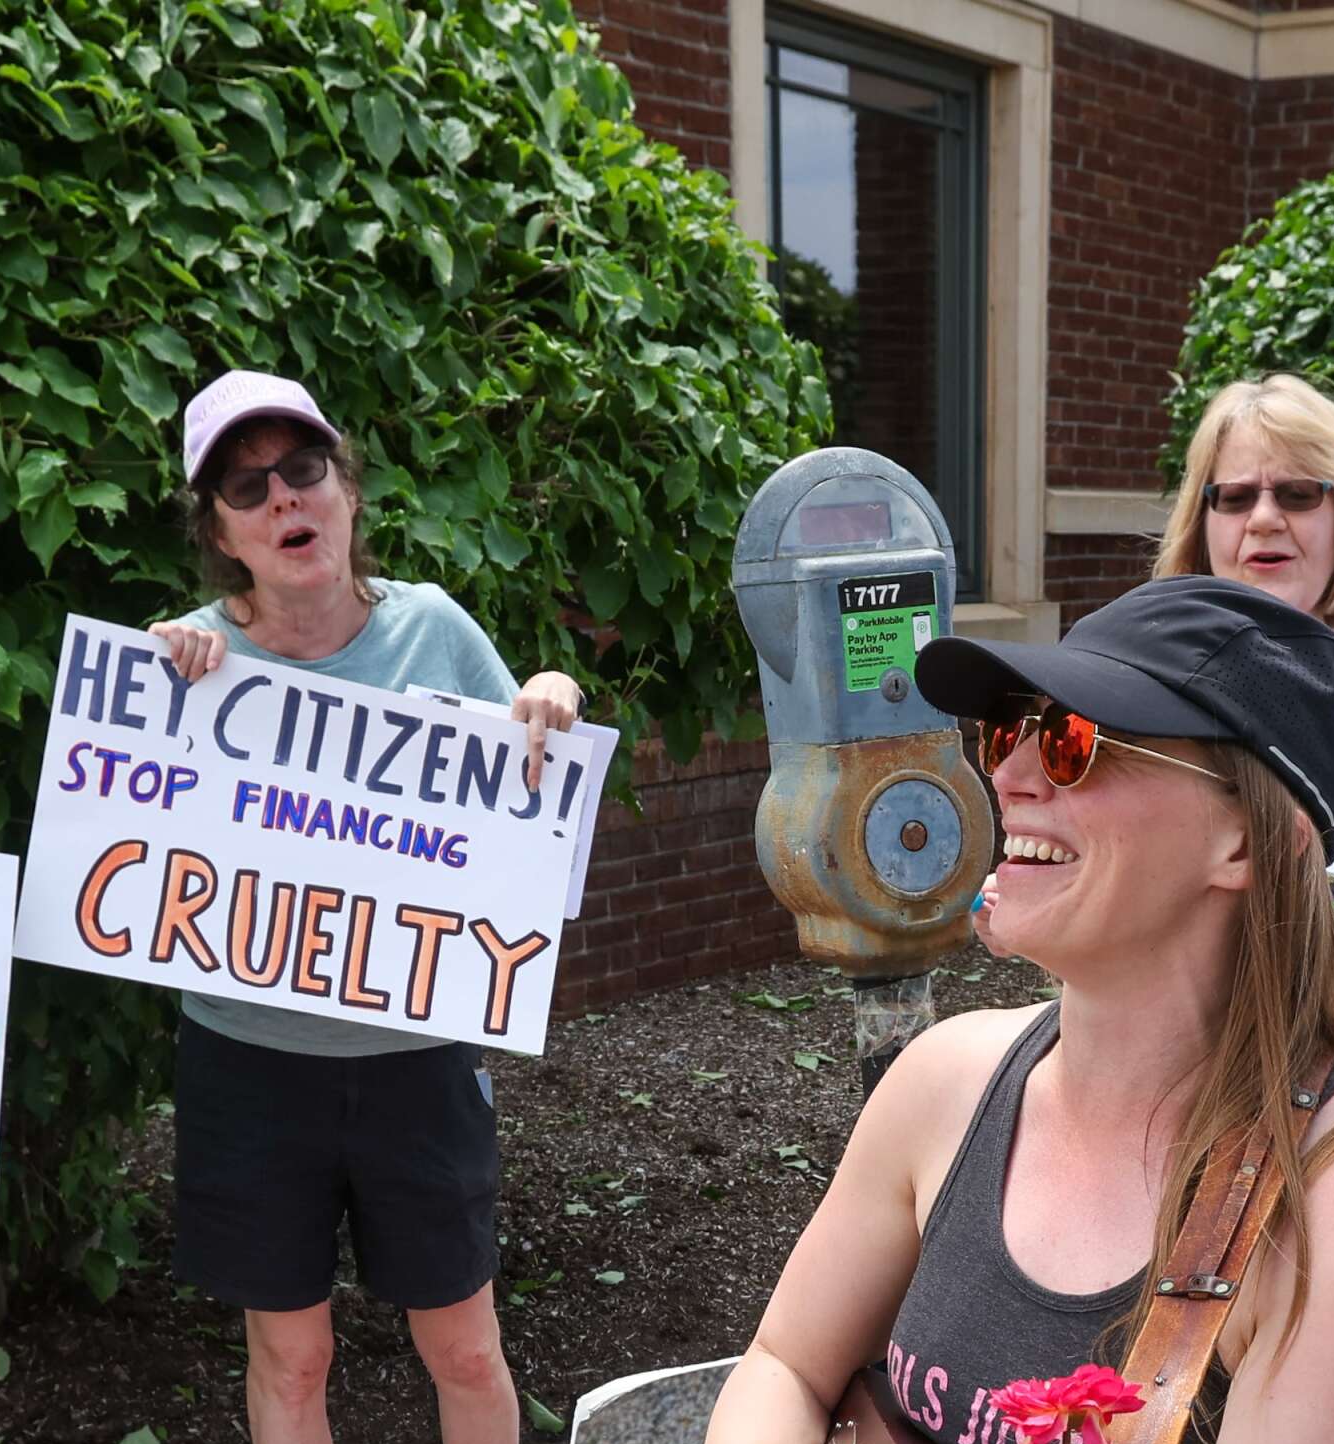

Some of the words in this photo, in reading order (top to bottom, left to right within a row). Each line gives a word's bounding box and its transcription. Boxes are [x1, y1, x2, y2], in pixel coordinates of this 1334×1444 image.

[854, 583, 901, 607] 7177
[858, 616, 905, 628] ParkMobile
[847, 635, 866, 645] Pay
[866, 633, 878, 644] by
[878, 632, 897, 642] App
[848, 645, 884, 656] Parking
[59, 628, 194, 753] HEY,
[213, 675, 585, 839] CITIZENS!
[58, 741, 199, 810] STOP
[232, 780, 469, 869] FINANCING
[75, 840, 551, 1036] CRUELTY
